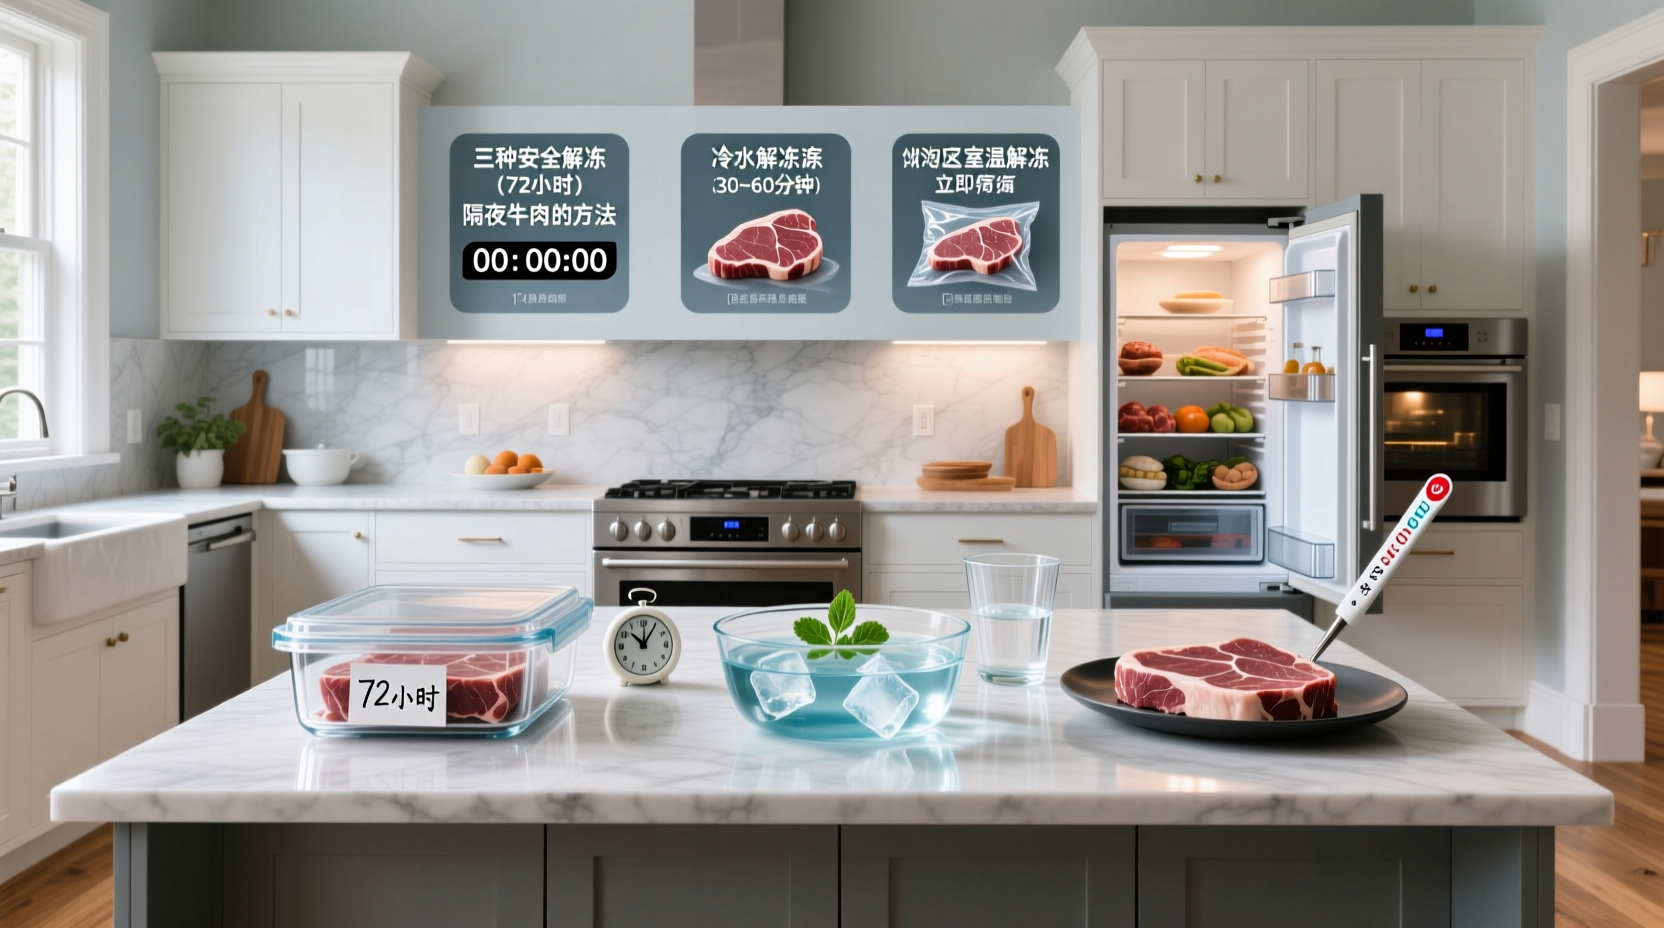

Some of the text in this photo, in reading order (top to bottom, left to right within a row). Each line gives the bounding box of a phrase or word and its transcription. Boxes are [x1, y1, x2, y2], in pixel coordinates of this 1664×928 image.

[473, 145, 606, 170] 三种安全解冻
[497, 173, 583, 196] (72小时)
[462, 202, 617, 227] 隔夜牛肉的方法
[358, 679, 440, 713] 72小时
